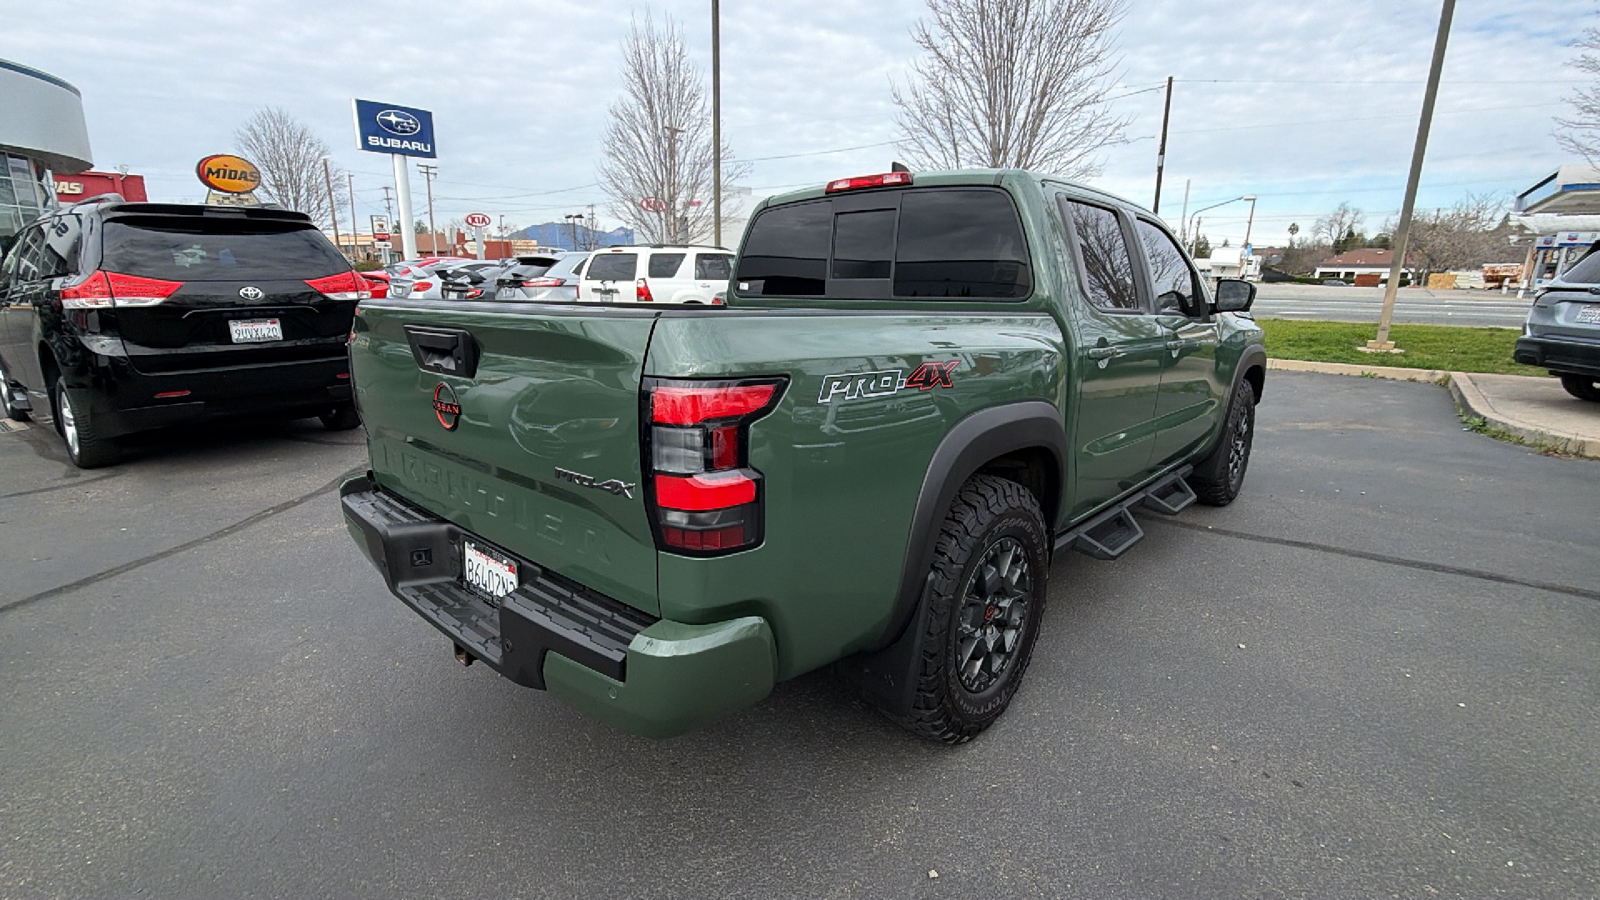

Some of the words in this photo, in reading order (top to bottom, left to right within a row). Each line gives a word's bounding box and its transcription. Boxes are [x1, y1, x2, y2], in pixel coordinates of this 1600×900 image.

[367, 135, 431, 153] SUBARU
[206, 166, 259, 182] MIDAS
[470, 216, 488, 224] KIA
